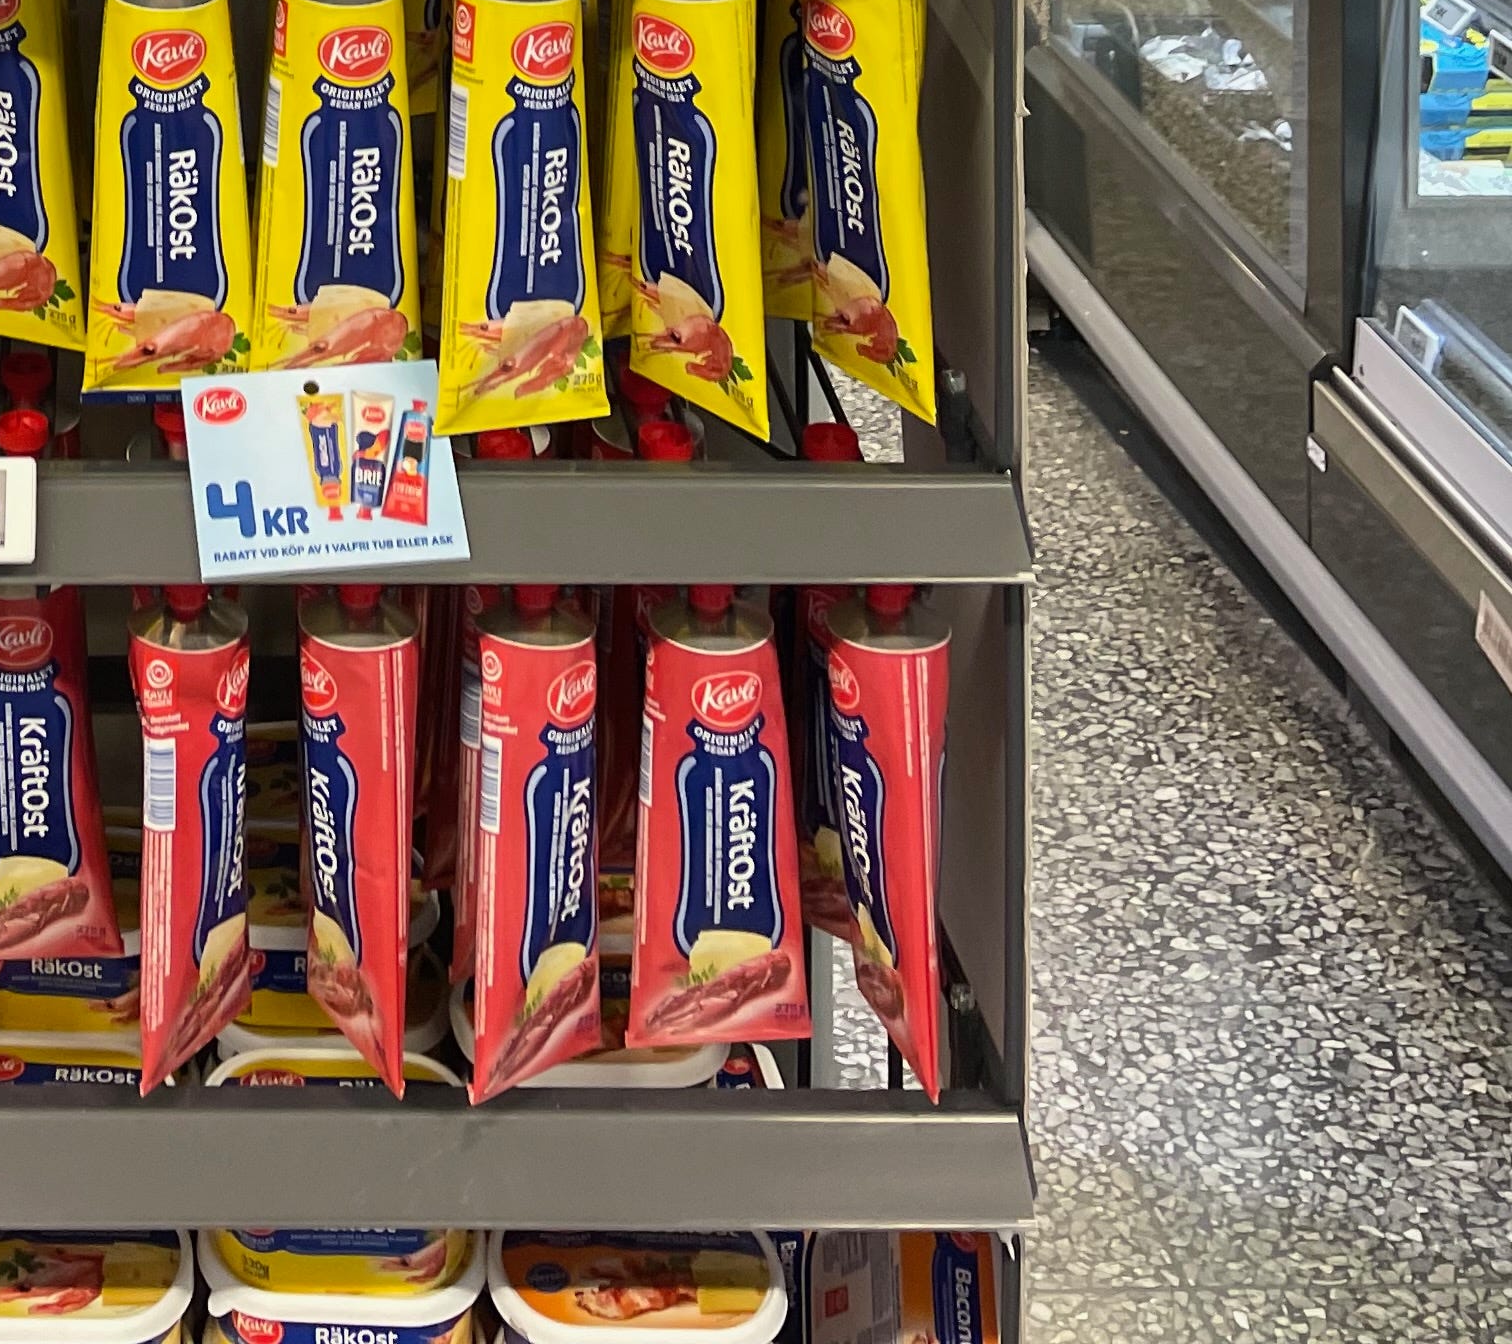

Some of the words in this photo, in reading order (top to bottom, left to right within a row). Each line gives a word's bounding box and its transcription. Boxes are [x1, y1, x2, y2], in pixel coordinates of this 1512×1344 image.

[141, 36, 200, 72] Kavli
[326, 33, 385, 70] Kavli
[520, 29, 574, 68] Kavli
[637, 16, 690, 59] Kavli
[134, 80, 204, 105] ORIGINALET
[320, 78, 392, 102] ORIGINALET
[667, 137, 693, 257] RäkOst
[835, 118, 864, 236] RäkOst
[168, 148, 198, 261] RäkOst
[347, 146, 380, 256] RäkOst
[539, 147, 567, 267] RäkOst
[355, 467, 383, 487] BRIE
[206, 479, 257, 539] 4
[263, 505, 311, 538] KR
[214, 549, 257, 563] RABATT
[260, 546, 279, 559] VID
[281, 542, 304, 557] KÖP
[307, 543, 323, 555] AV
[331, 539, 370, 553] VALFRI
[372, 538, 394, 551] TUB
[395, 536, 429, 550] ELLER
[431, 534, 454, 547] ASK
[701, 676, 758, 718] Kavli
[693, 719, 763, 747] ORIGINALET
[18, 717, 50, 839] KräftOst
[559, 777, 591, 922] KräftOst
[728, 779, 755, 911] KräftOst
[30, 957, 104, 981] RäkOst
